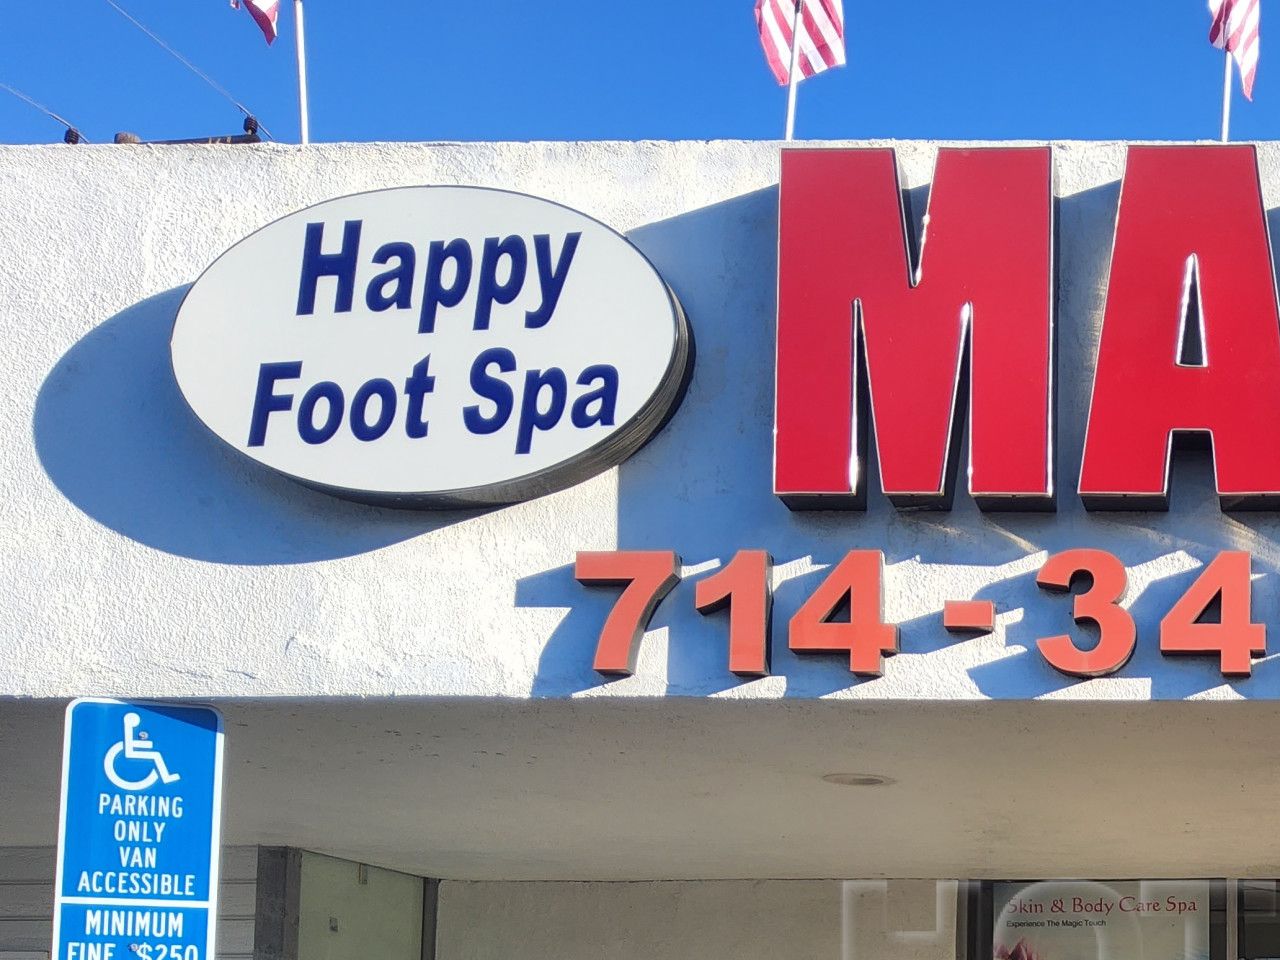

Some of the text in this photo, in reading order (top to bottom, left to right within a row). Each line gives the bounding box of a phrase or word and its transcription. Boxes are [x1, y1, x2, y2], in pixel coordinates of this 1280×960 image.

[296, 219, 582, 334] Happy
[247, 347, 620, 455] Foot Spa
[99, 793, 183, 818] PARKING
[114, 820, 166, 842] ONLY
[119, 846, 157, 869] VAN
[77, 871, 195, 896] ACCESSIBLE
[1007, 896, 1198, 916] Skin & Body Care Spa
[85, 909, 184, 938] MINIMUM
[1006, 919, 1106, 928] Experience The Magic Touch
